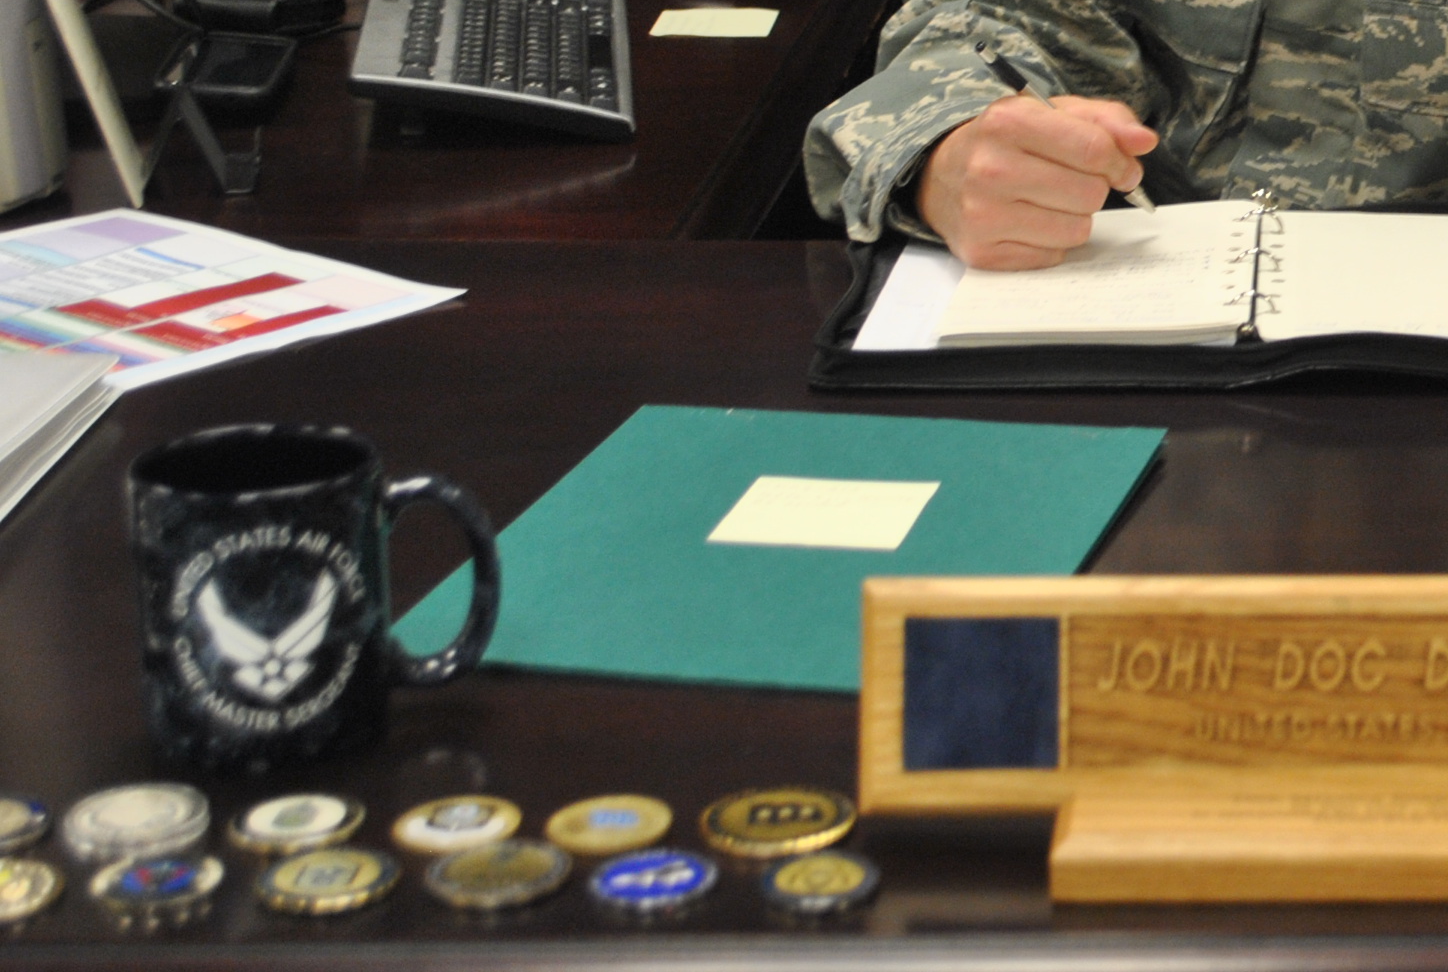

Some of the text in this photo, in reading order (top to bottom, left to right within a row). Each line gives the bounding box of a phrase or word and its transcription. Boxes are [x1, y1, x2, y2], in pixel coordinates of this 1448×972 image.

[213, 526, 291, 561] STATES
[296, 531, 331, 553] AIR
[328, 542, 367, 603] FORCE
[174, 636, 361, 731] CHIEF MASTER SERGEANT
[1097, 636, 1237, 693] JOHN
[1273, 636, 1387, 693] DOC
[1196, 712, 1314, 742] UNITED
[1323, 712, 1438, 741] STATES
